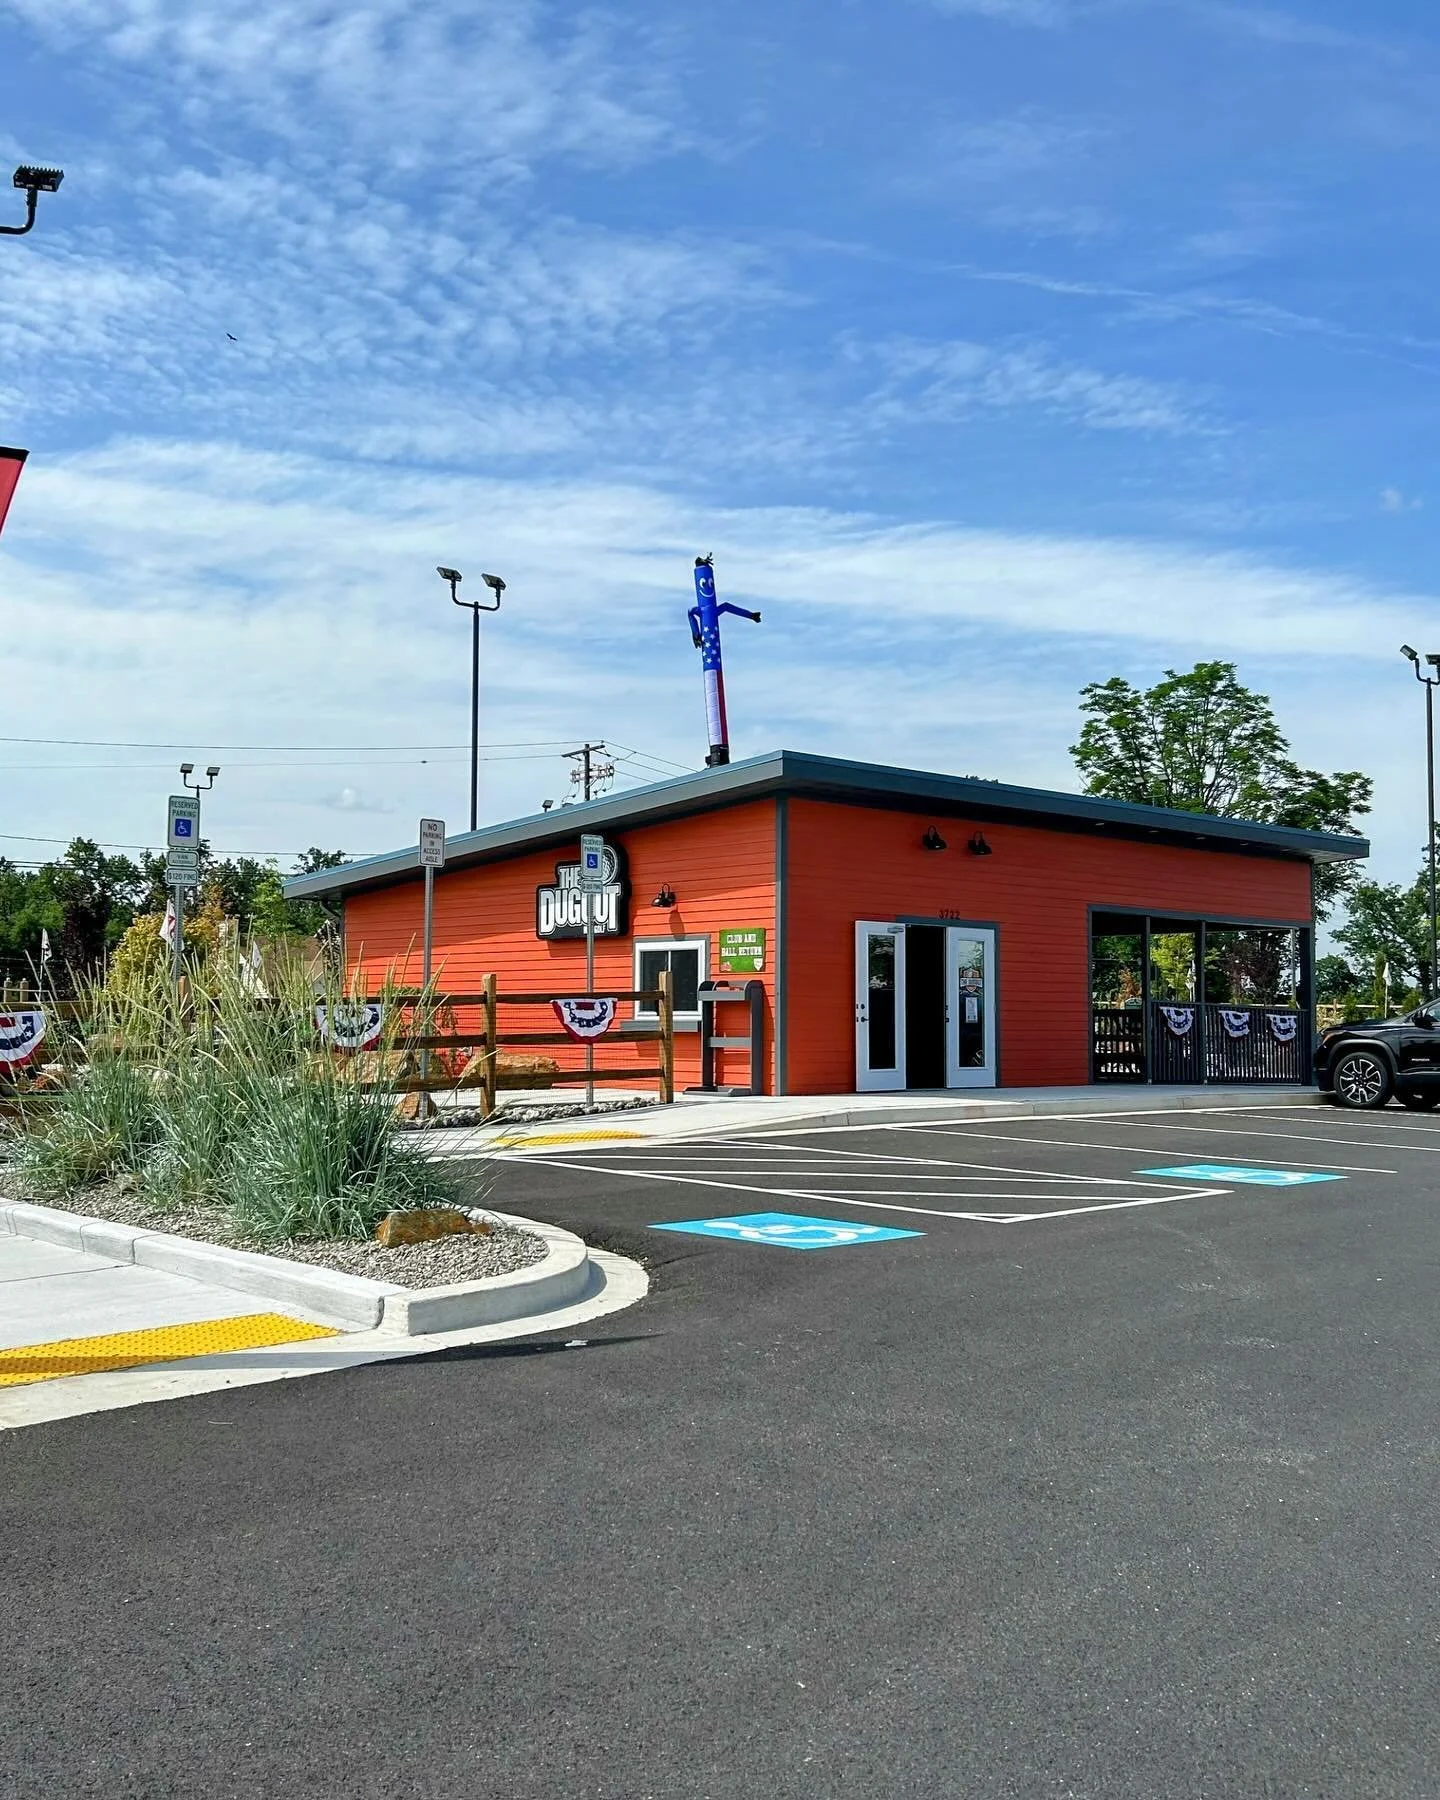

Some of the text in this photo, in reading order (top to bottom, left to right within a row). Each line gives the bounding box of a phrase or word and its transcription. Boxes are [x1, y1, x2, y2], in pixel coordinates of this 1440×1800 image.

[171, 800, 199, 810] RESERVED
[172, 809, 196, 818] PARKING
[427, 823, 438, 831] NO
[423, 831, 442, 840] PARKING
[559, 867, 582, 888] THE
